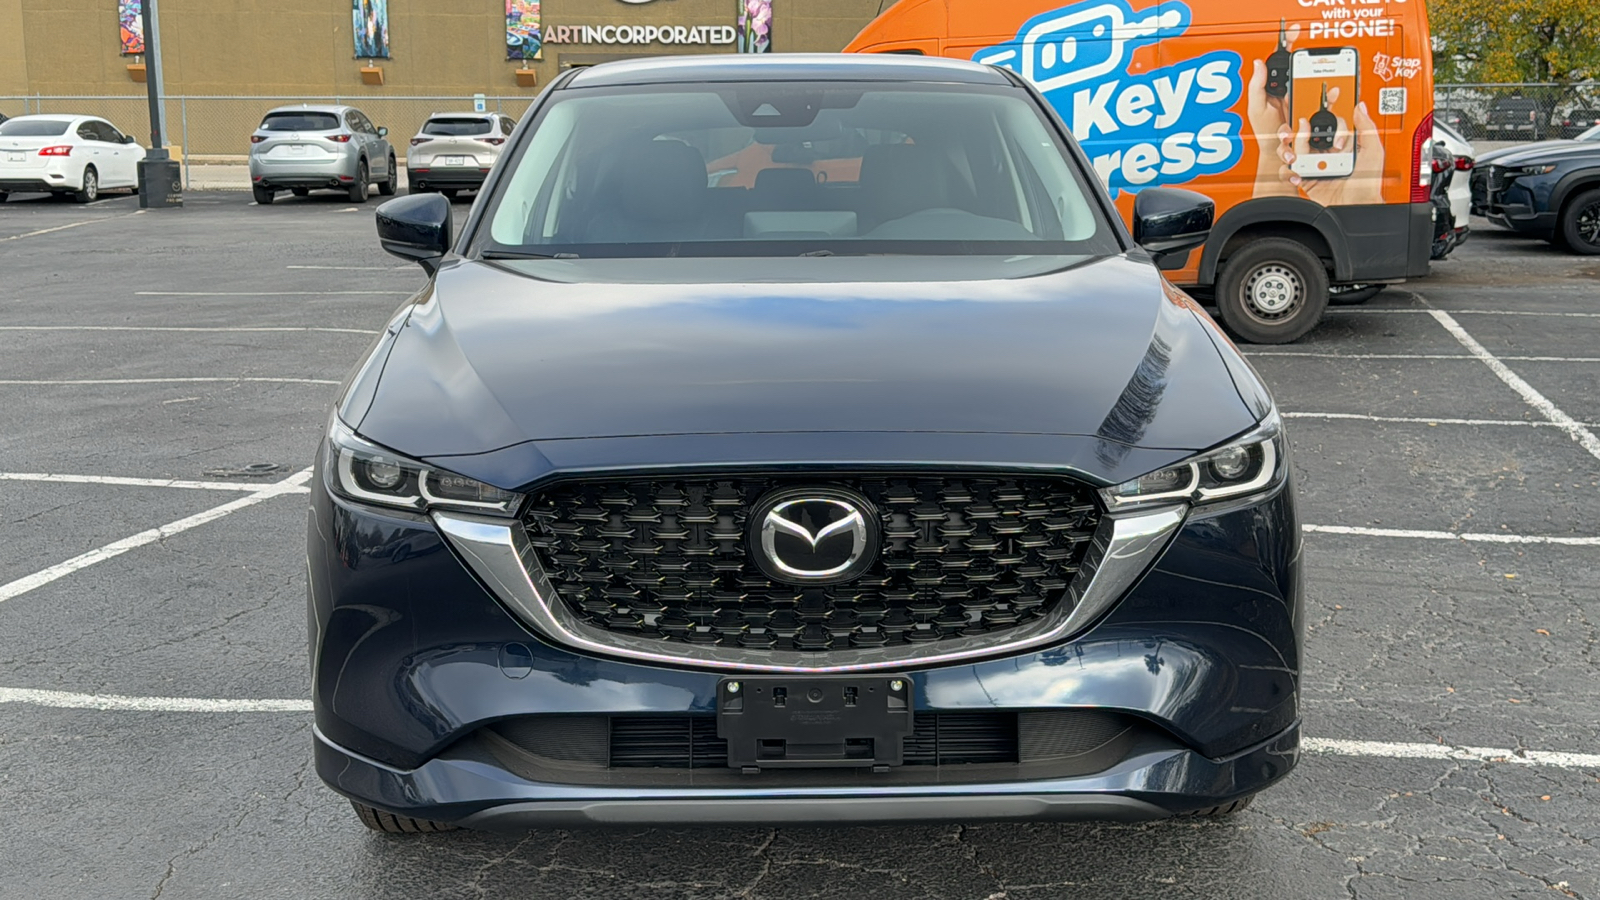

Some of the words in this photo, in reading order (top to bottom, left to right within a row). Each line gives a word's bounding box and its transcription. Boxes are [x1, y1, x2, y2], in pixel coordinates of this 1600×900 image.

[1321, 7, 1351, 19] with
[1353, 8, 1384, 20] your
[1309, 19, 1395, 39] PHONE!
[1391, 56, 1421, 68] Snap
[1394, 67, 1418, 79] Key
[1073, 60, 1233, 142] Keys
